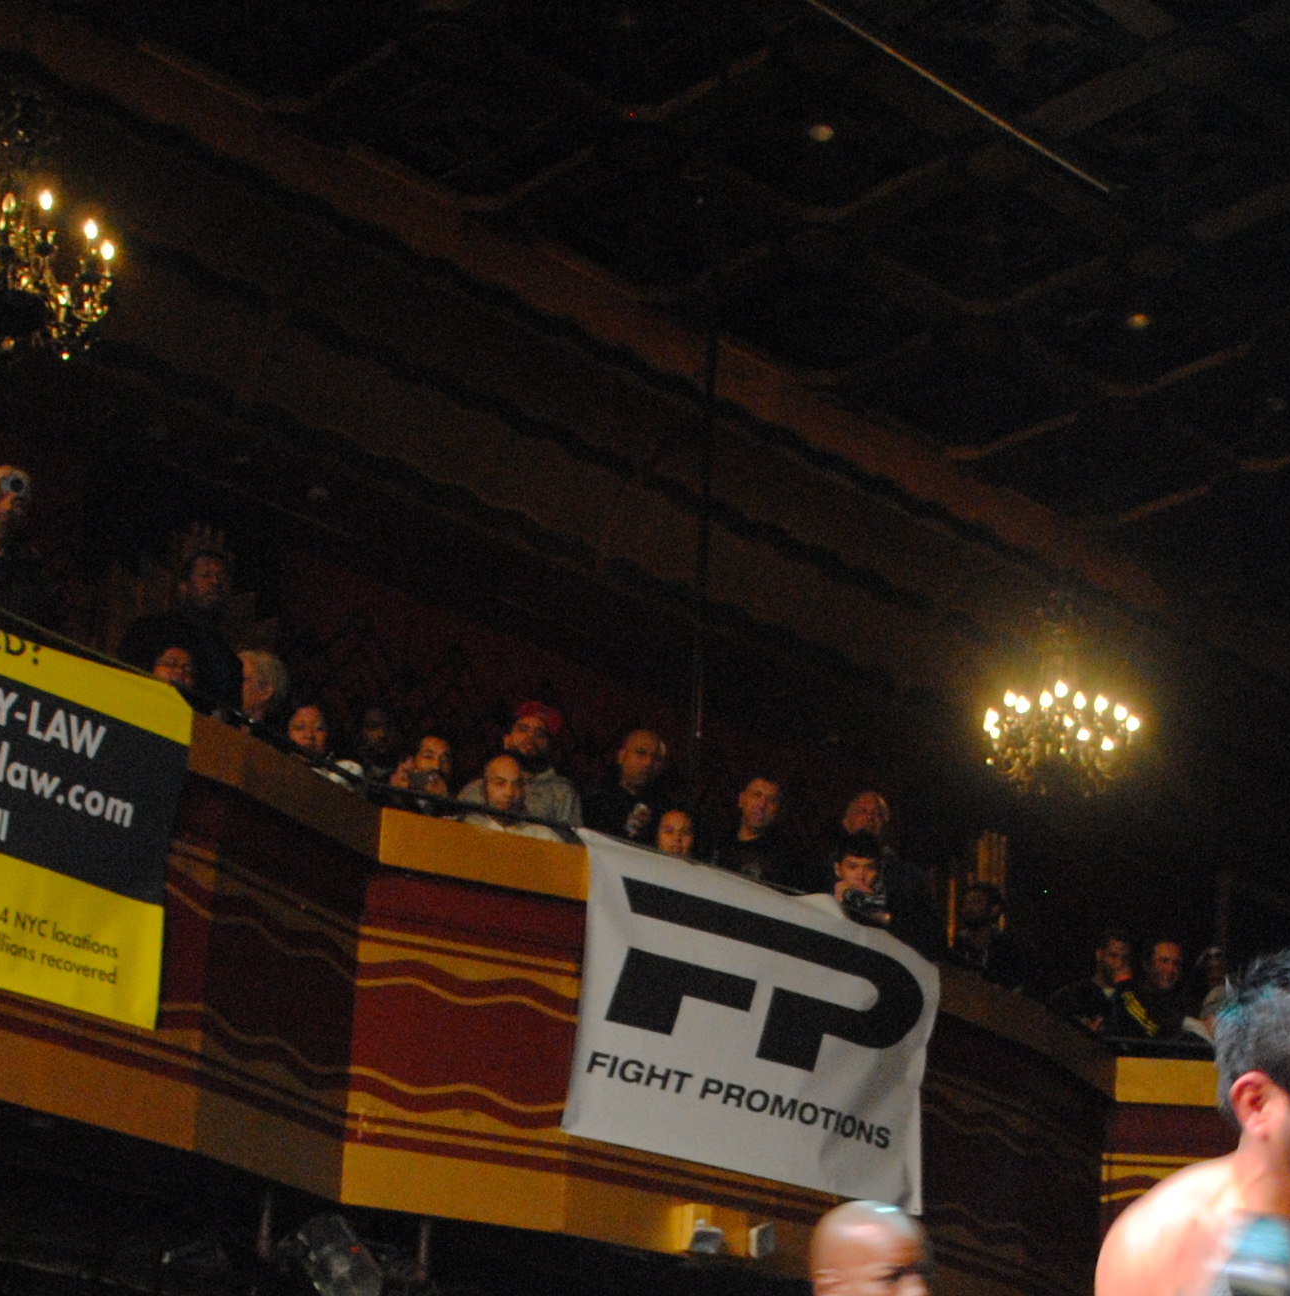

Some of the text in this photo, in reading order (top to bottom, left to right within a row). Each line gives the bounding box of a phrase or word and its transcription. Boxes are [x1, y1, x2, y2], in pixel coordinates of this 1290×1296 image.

[14, 911, 48, 937] NYC
[52, 922, 118, 958] locations
[40, 952, 117, 984] recovered
[585, 1050, 892, 1150] FIGHT PROMOTIONS
